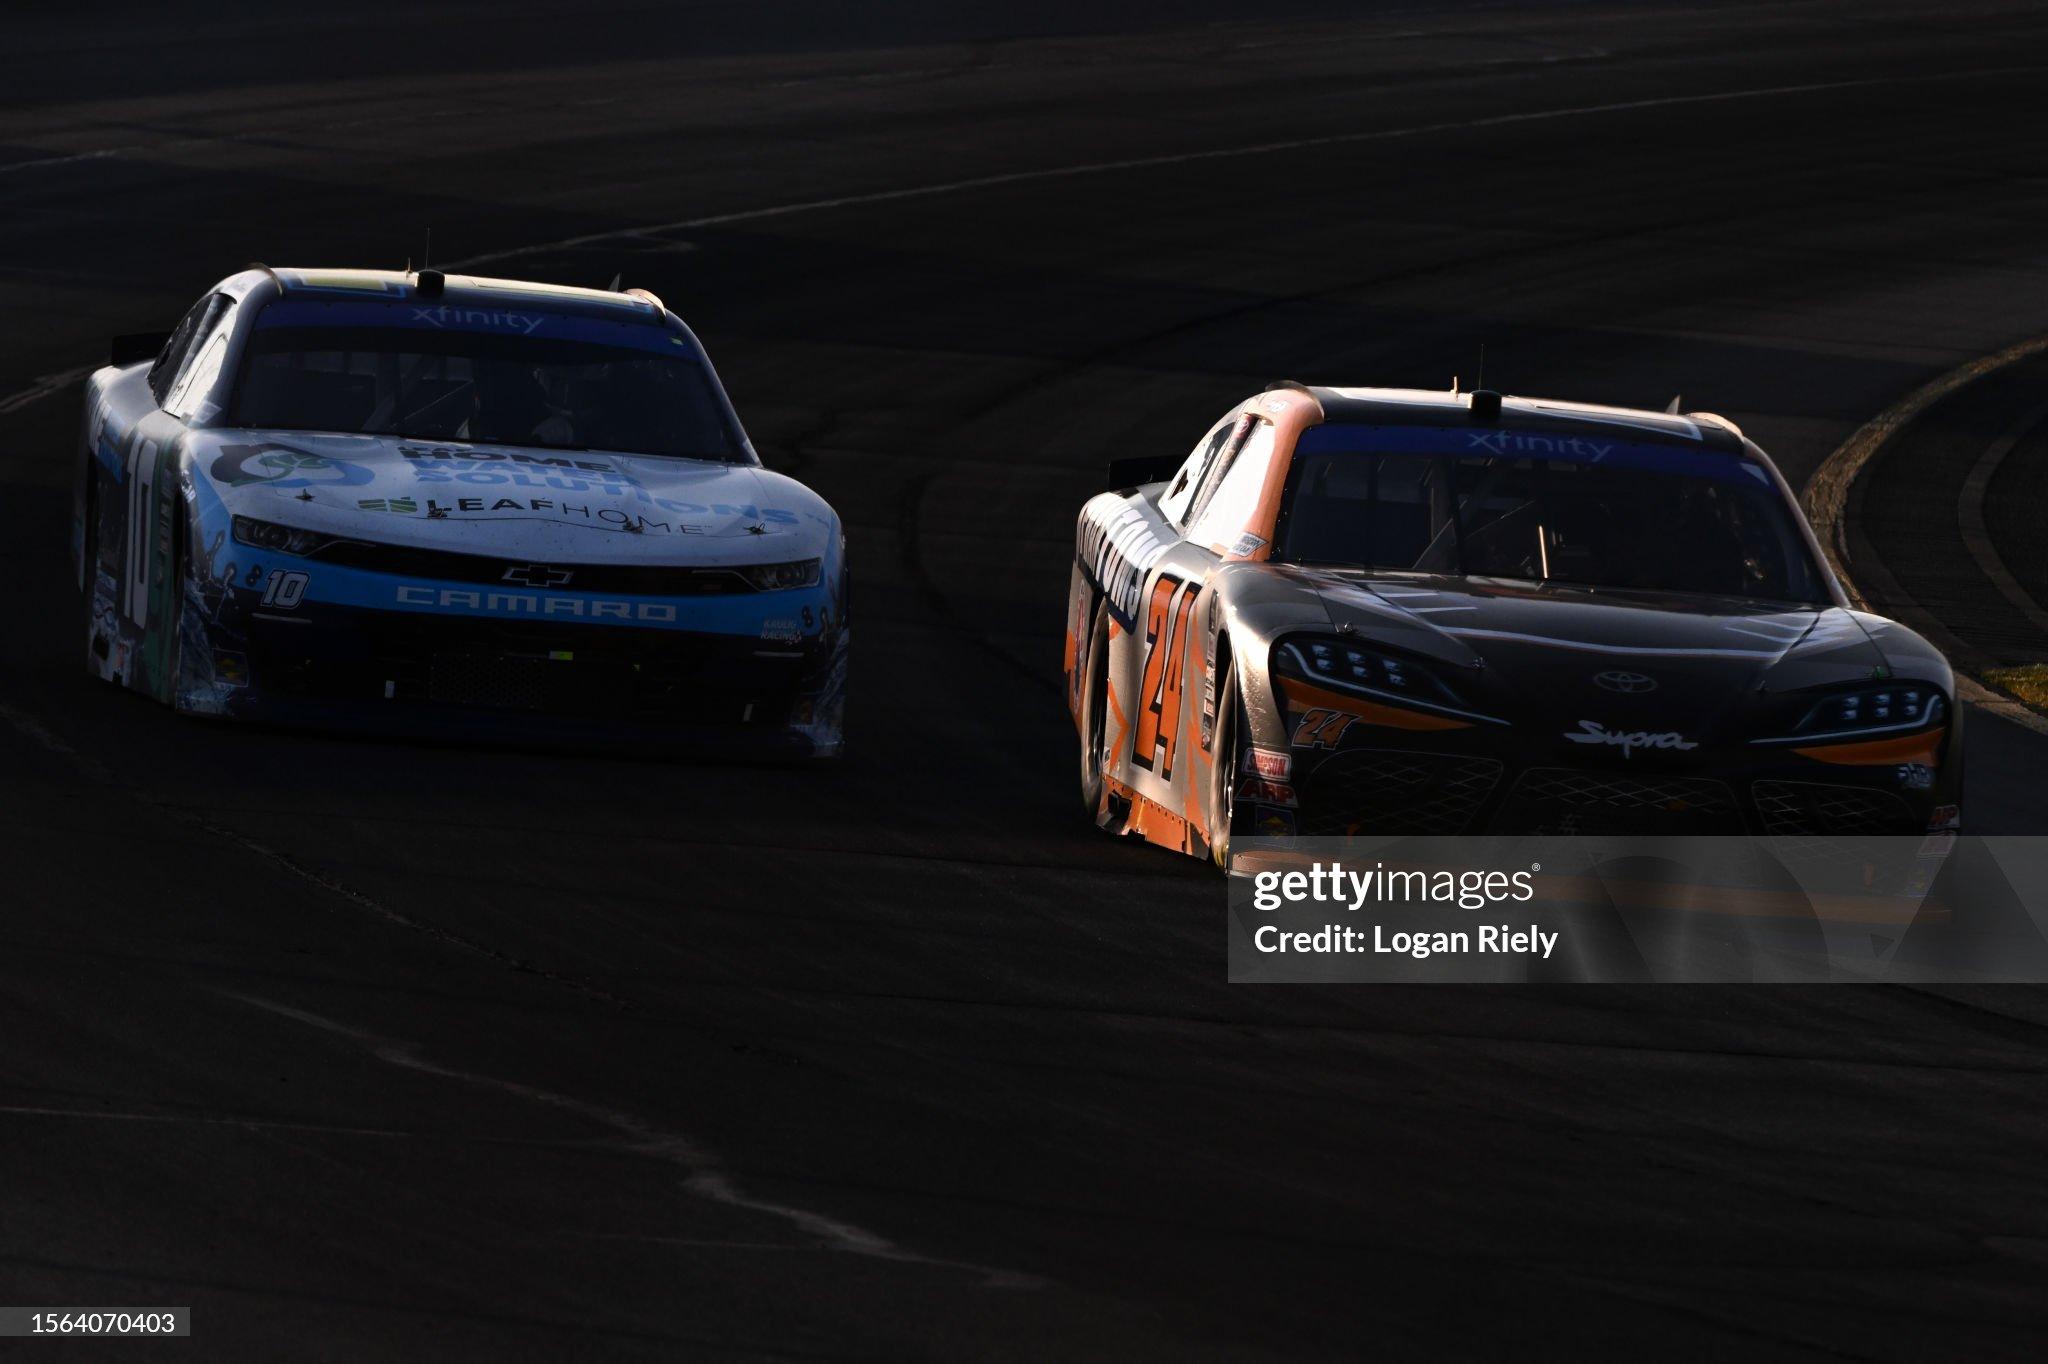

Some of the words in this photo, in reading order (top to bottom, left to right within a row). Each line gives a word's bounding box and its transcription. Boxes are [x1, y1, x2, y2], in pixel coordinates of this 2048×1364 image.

[411, 304, 545, 335] xfinity
[398, 445, 617, 473] HOME
[1467, 429, 1614, 463] xfinity
[414, 470, 800, 525] SOLUTIONS
[124, 431, 158, 630] 10
[260, 567, 311, 610] 10
[397, 586, 677, 622] CAMARO
[1130, 571, 1202, 782] 24
[1292, 707, 1361, 750] 24
[1563, 719, 1699, 760] Supra
